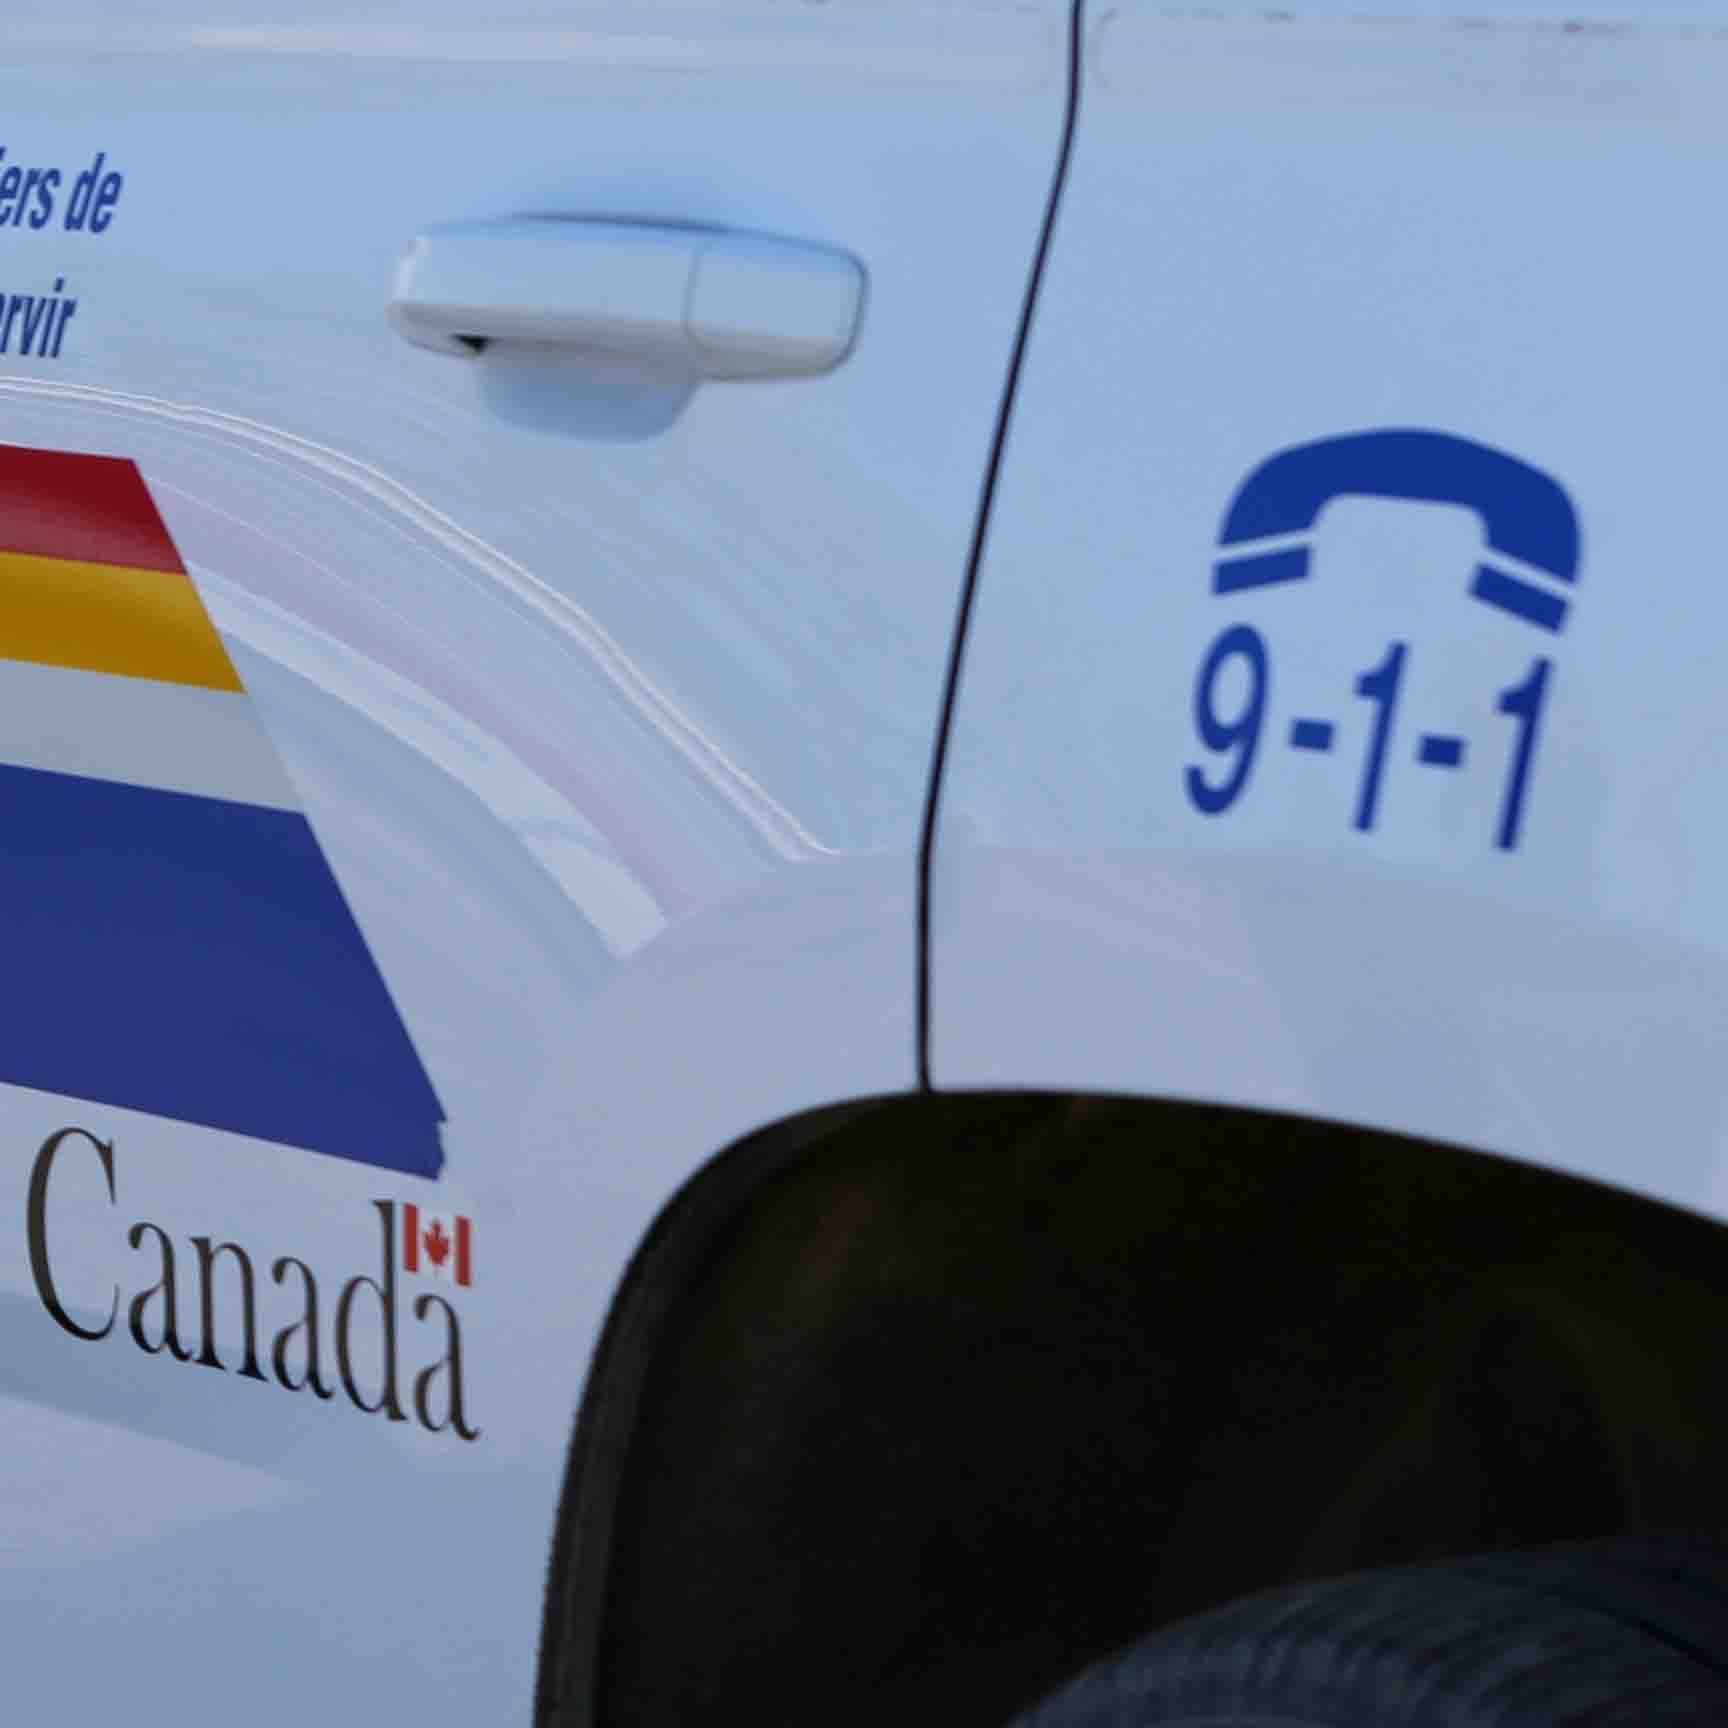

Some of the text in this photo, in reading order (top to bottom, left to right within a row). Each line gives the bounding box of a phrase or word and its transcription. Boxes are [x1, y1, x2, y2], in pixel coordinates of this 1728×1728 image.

[64, 152, 123, 233] de
[1184, 622, 1556, 852] 9-1-1
[25, 1126, 481, 1442] Canada
